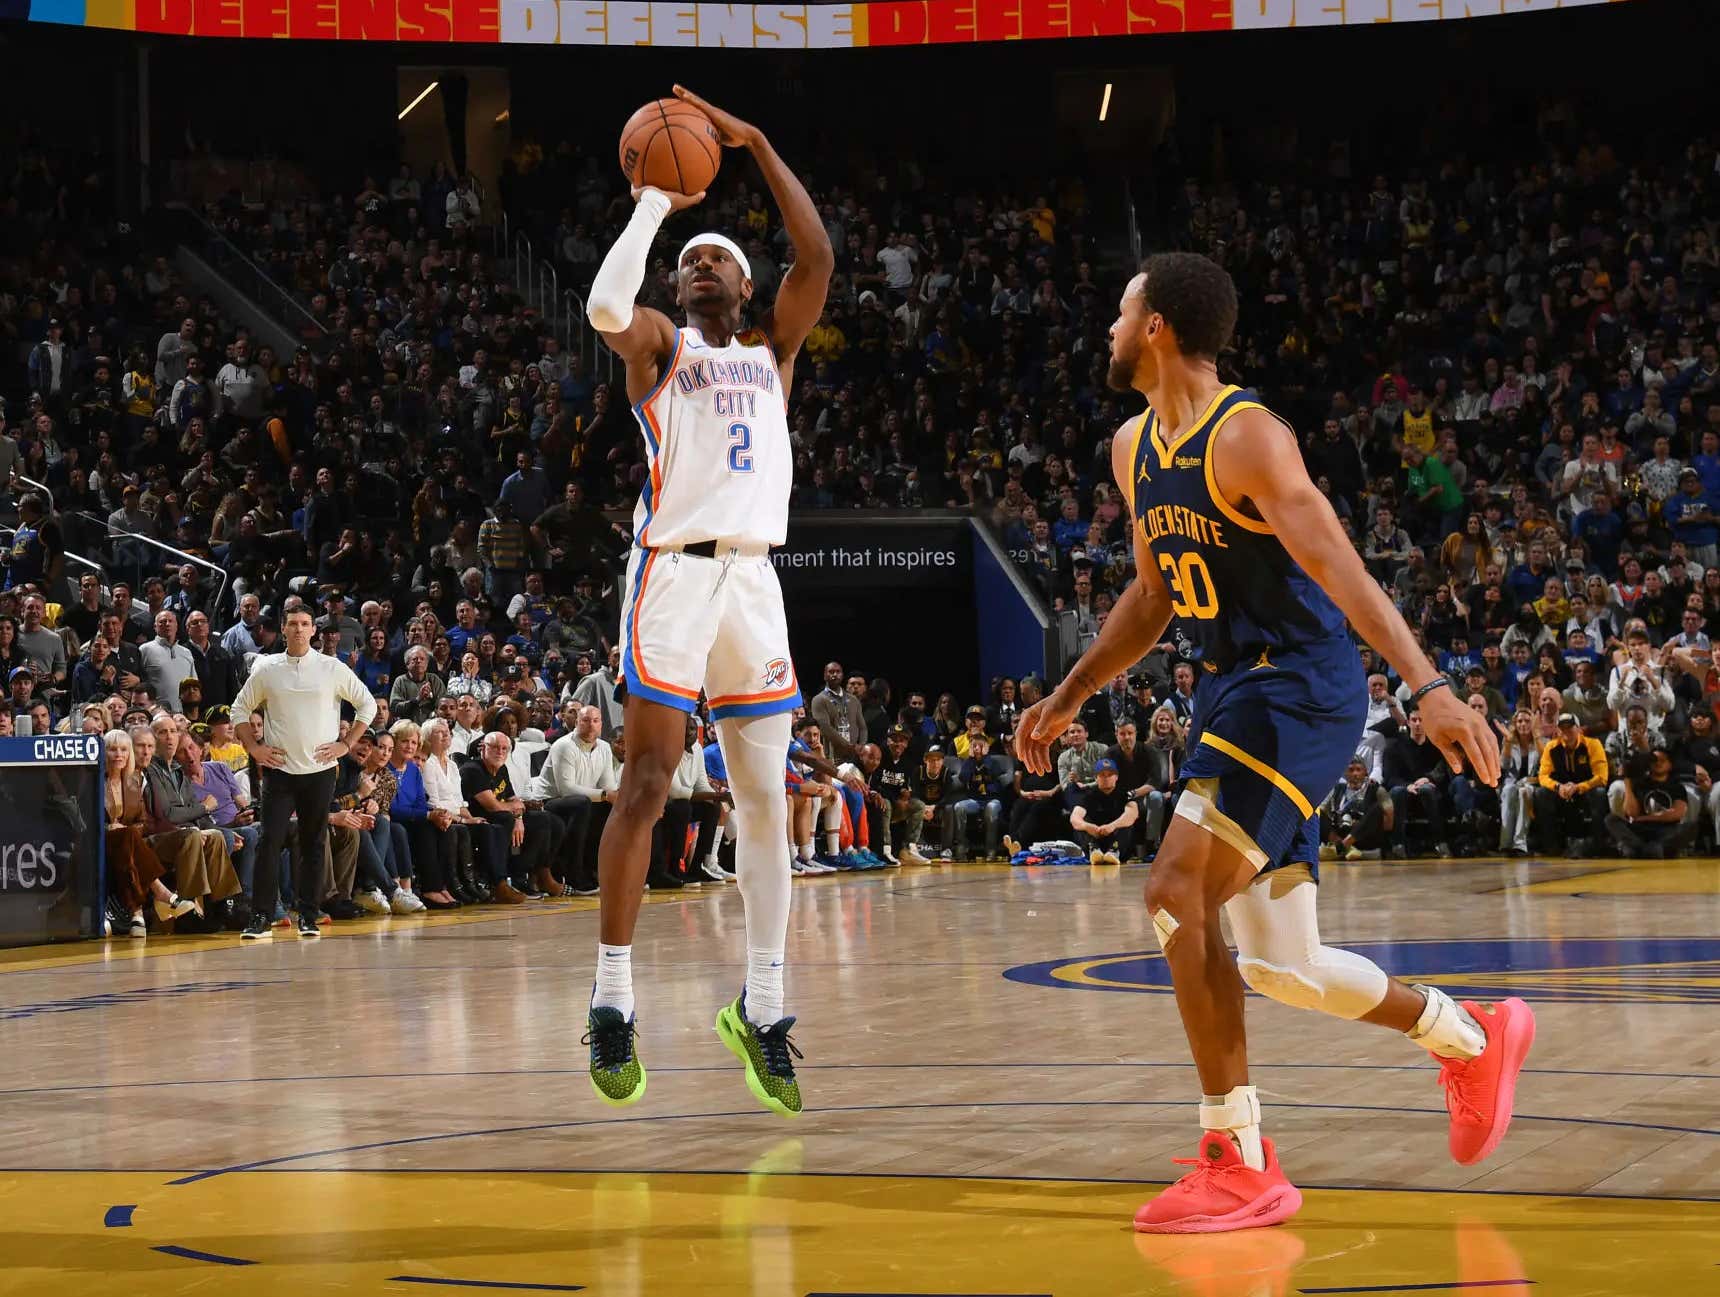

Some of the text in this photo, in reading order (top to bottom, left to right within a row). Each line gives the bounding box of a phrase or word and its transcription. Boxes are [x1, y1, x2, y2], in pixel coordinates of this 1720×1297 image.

[136, 0, 499, 42] DEFENSE
[501, 0, 852, 48] DEFENSE
[868, 0, 1232, 47] DEFENSE
[676, 359, 775, 394] OKLAHOMA
[714, 390, 757, 417] CITY
[727, 421, 754, 473] 2
[1176, 456, 1201, 466] Rakuten
[768, 547, 956, 570] ment that inspires
[1159, 552, 1219, 619] 30
[34, 739, 84, 760] CHASE
[2, 842, 57, 889] res
